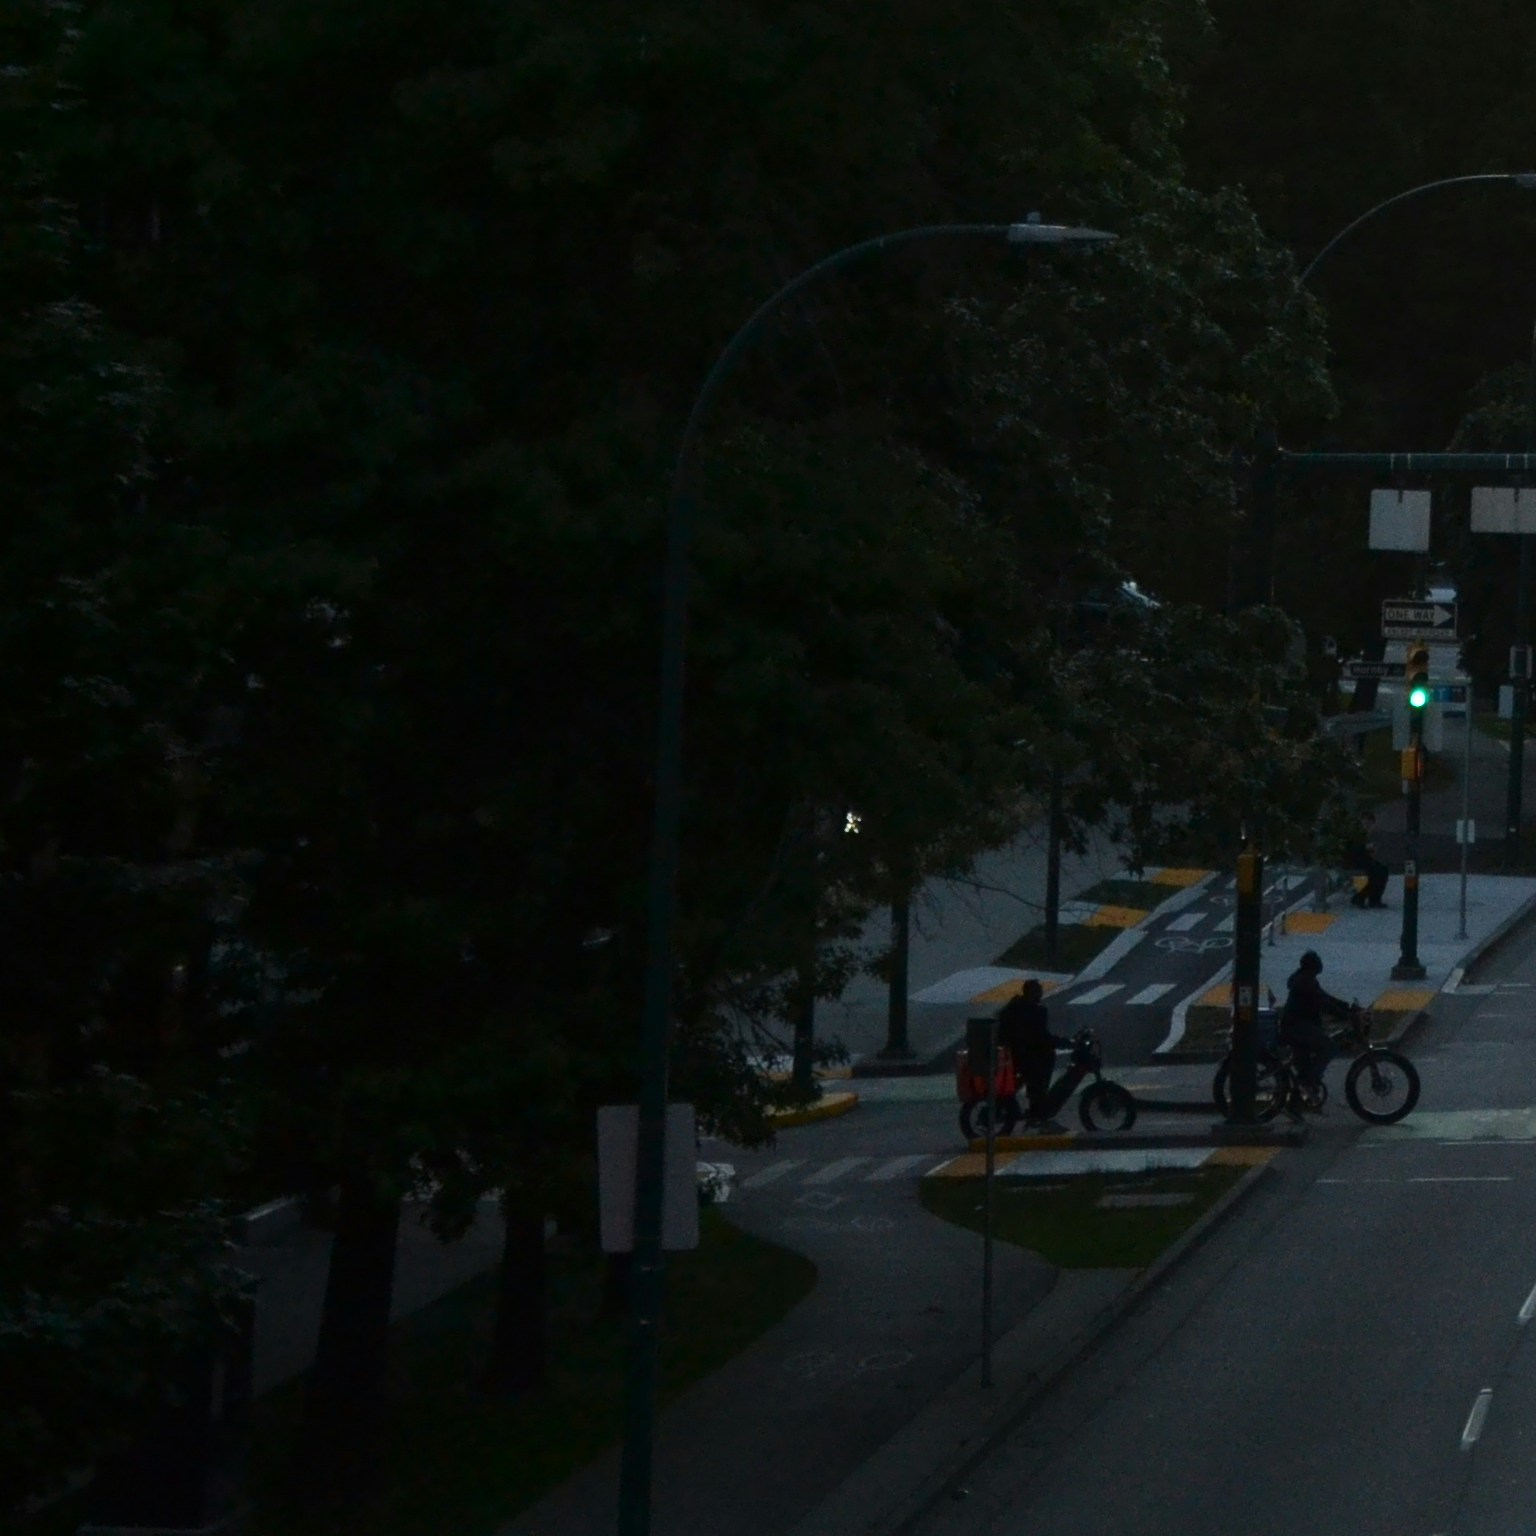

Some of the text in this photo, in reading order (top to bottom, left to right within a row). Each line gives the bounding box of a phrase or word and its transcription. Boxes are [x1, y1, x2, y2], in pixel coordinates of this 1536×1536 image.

[1386, 609, 1435, 622] ONE WAY
[1352, 665, 1390, 677] Hornby
